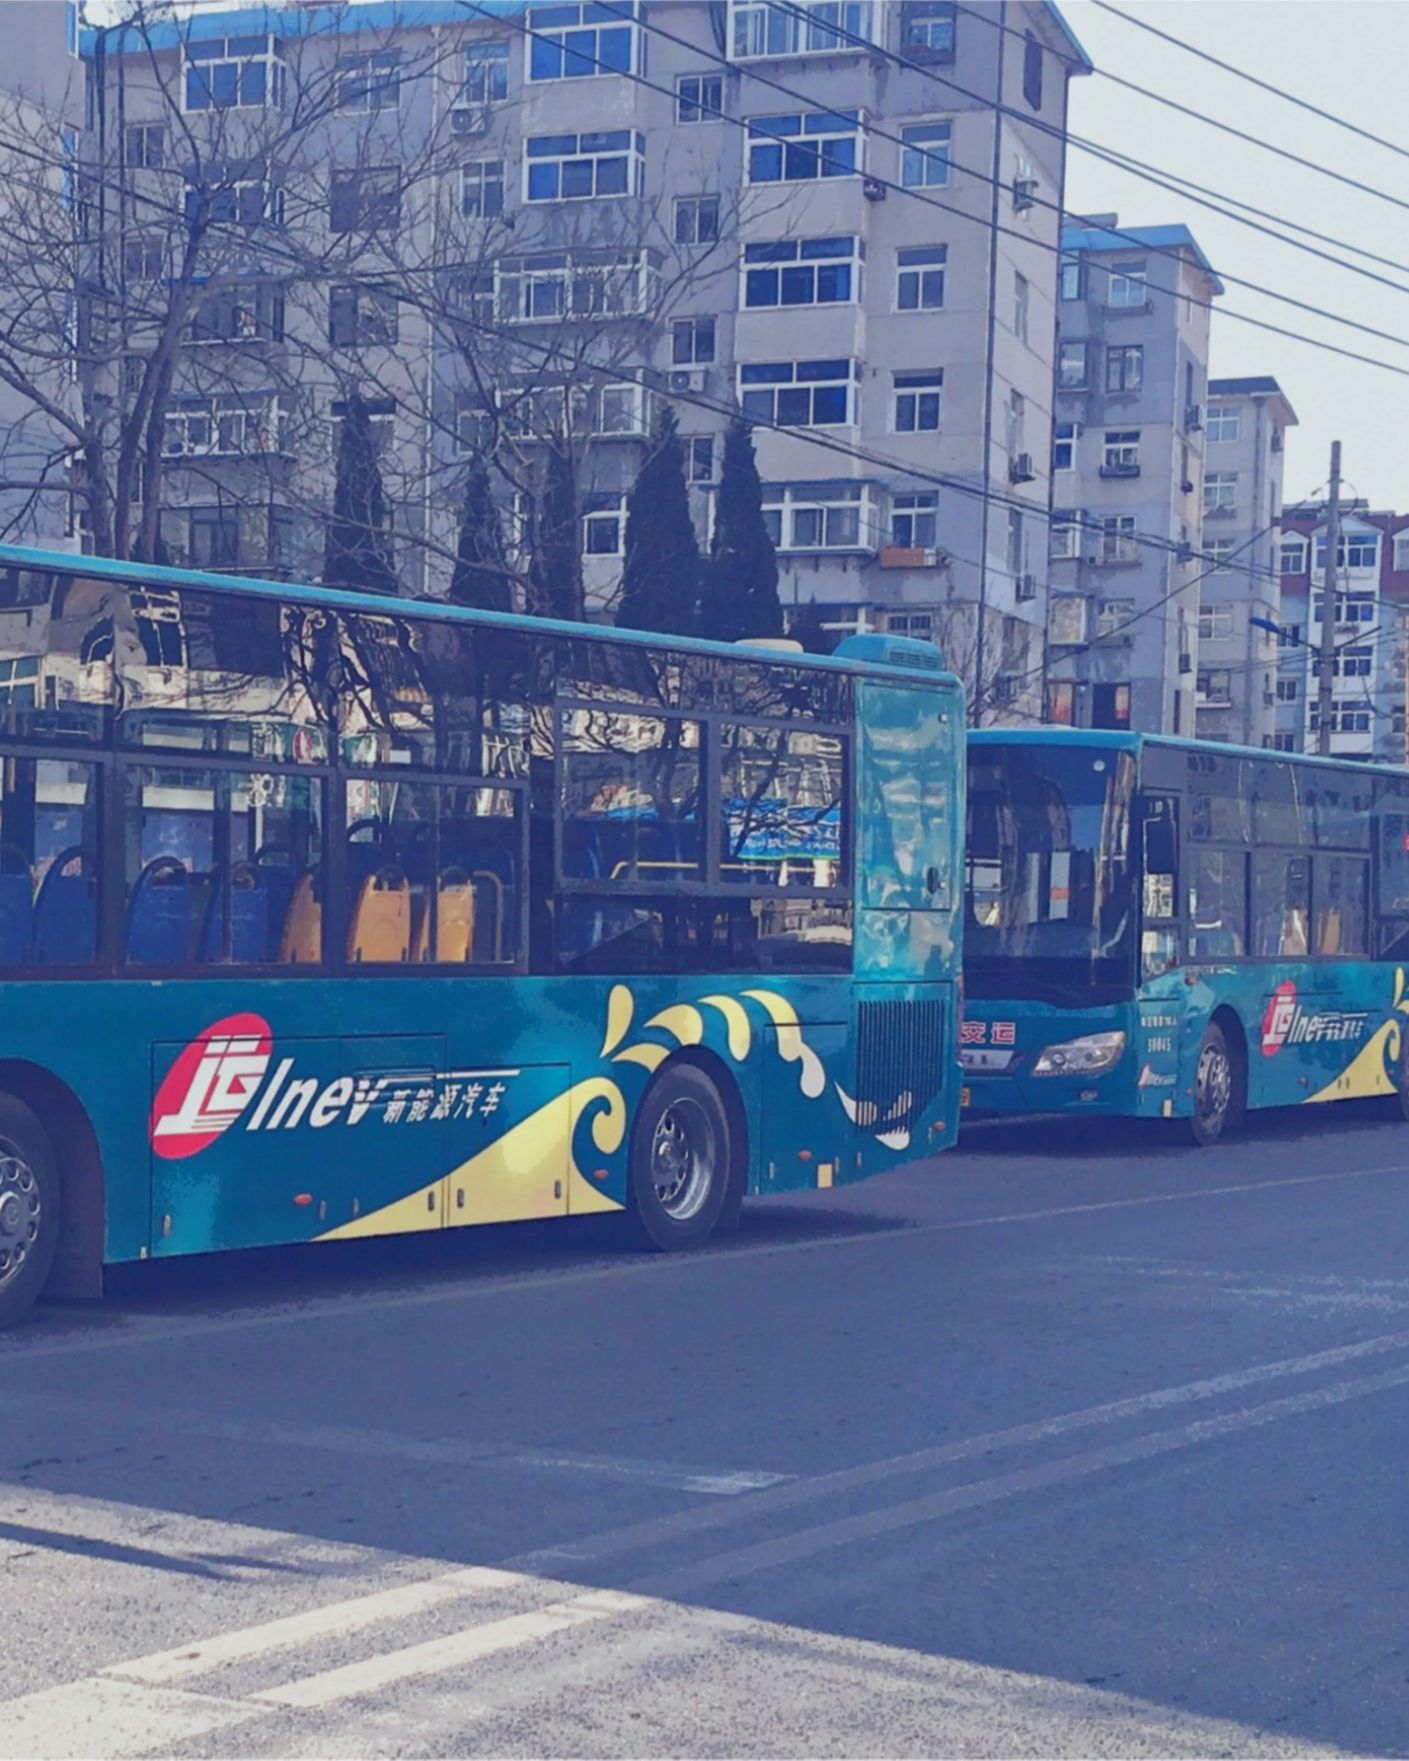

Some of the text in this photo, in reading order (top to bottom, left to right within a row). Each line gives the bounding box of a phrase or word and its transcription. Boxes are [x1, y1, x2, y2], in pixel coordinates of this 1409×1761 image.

[959, 1020, 1016, 1045] 交运
[382, 1081, 506, 1124] 新能源汽车
